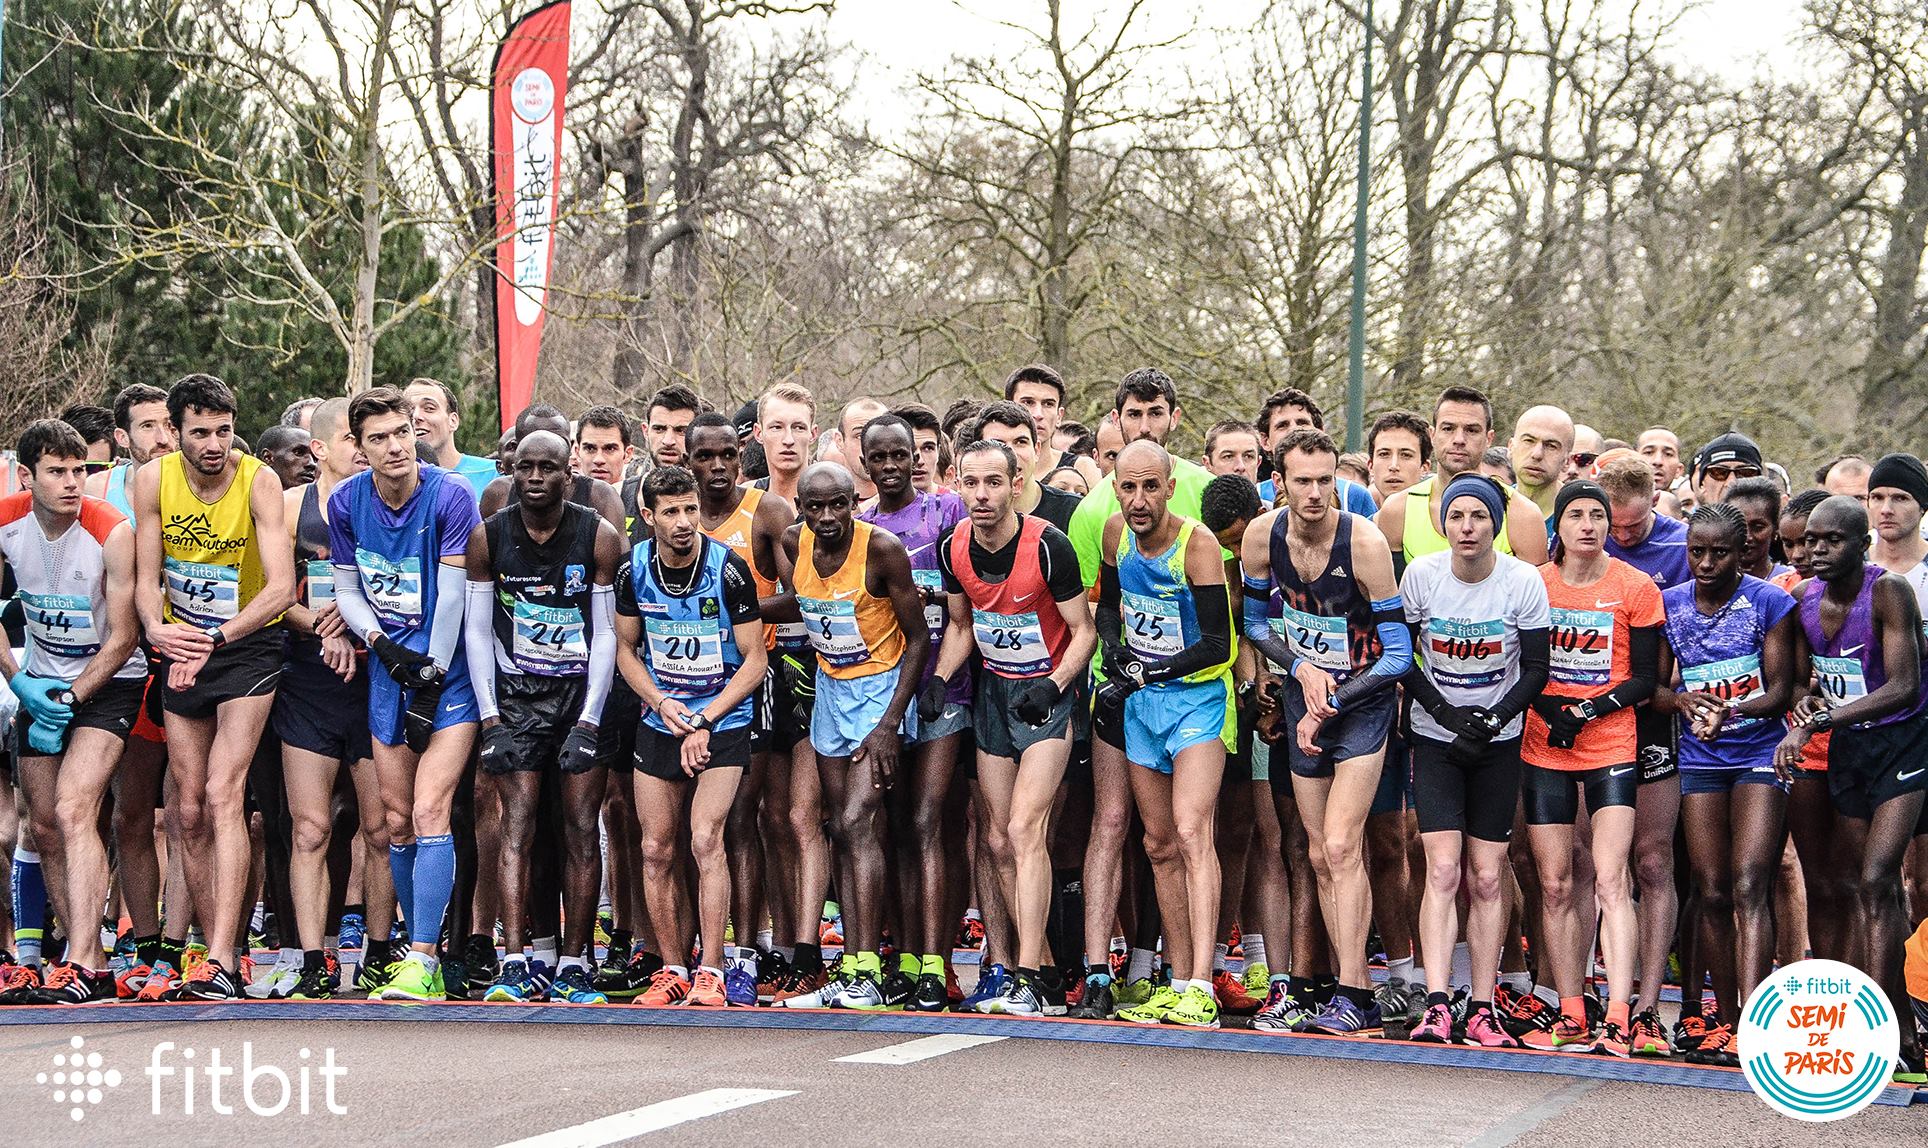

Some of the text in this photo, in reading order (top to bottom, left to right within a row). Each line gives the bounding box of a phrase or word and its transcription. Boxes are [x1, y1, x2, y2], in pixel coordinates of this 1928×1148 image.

[522, 153, 547, 245] ftbit
[191, 566, 222, 579] fitbit
[183, 579, 218, 603] 45
[370, 573, 402, 597] 52
[44, 596, 75, 609] fitbit
[189, 603, 214, 613] Adrien
[816, 601, 840, 614] fitbit
[1141, 600, 1165, 614] fitbit
[39, 610, 72, 633] 44
[543, 611, 574, 623] fitbit
[996, 614, 1024, 627] fitbit
[1134, 612, 1165, 641] 25
[1303, 616, 1331, 631] fitbit
[1566, 611, 1597, 625] fitbit
[531, 622, 567, 651] 24
[672, 624, 704, 635] fitbit
[821, 615, 832, 640] 8
[1457, 624, 1489, 636] fitbit
[45, 632, 75, 643] Simpson
[992, 628, 1022, 651] 28
[1297, 627, 1330, 655] 26
[1549, 625, 1601, 655] 102
[664, 636, 701, 661] 20
[1442, 637, 1490, 661] 106
[1712, 660, 1744, 679] fitbit
[1821, 660, 1847, 673] fitbit
[1701, 674, 1752, 701] 103
[1823, 674, 1846, 699] 10
[1644, 763, 1675, 779] UniRun
